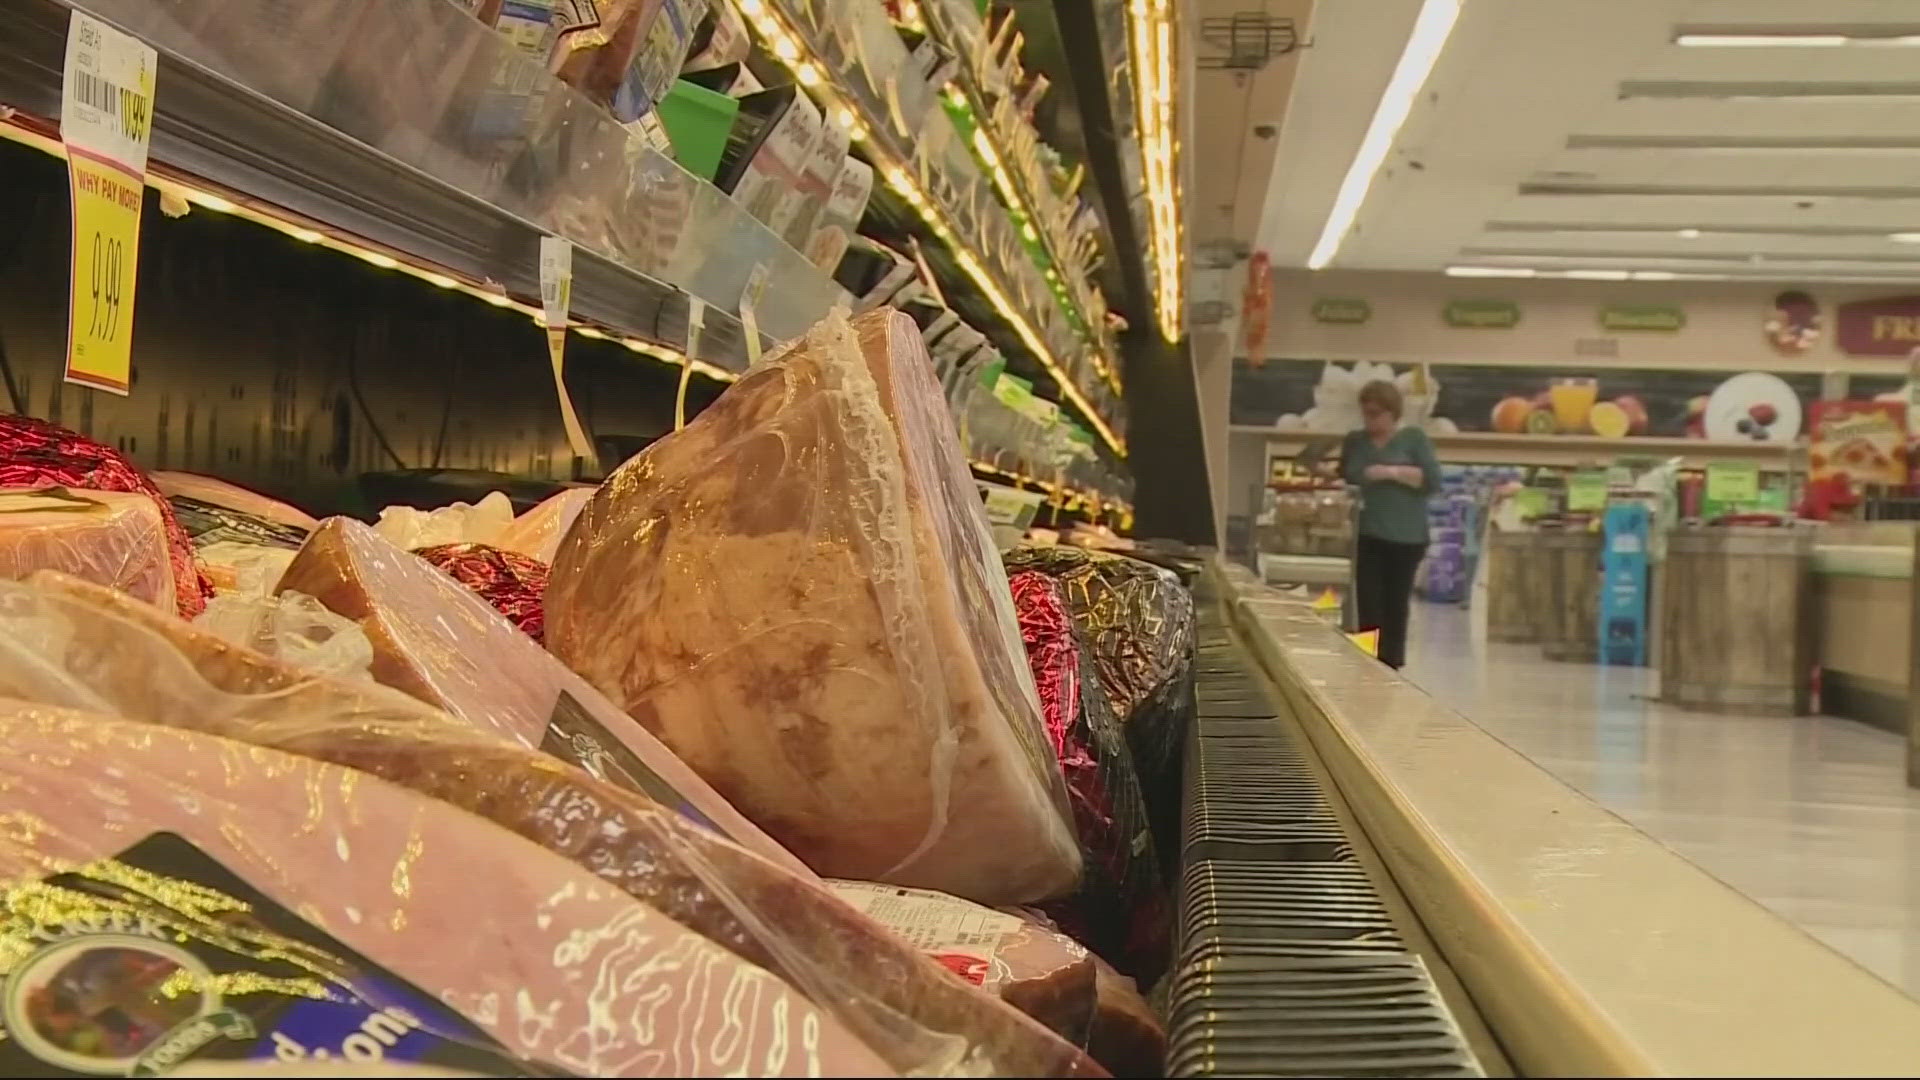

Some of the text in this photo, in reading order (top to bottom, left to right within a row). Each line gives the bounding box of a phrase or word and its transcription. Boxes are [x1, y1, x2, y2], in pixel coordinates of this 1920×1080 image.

[119, 87, 146, 144] 10.99
[76, 167, 100, 194] WHY
[101, 176, 118, 203] PAY
[89, 231, 122, 342] 9.99
